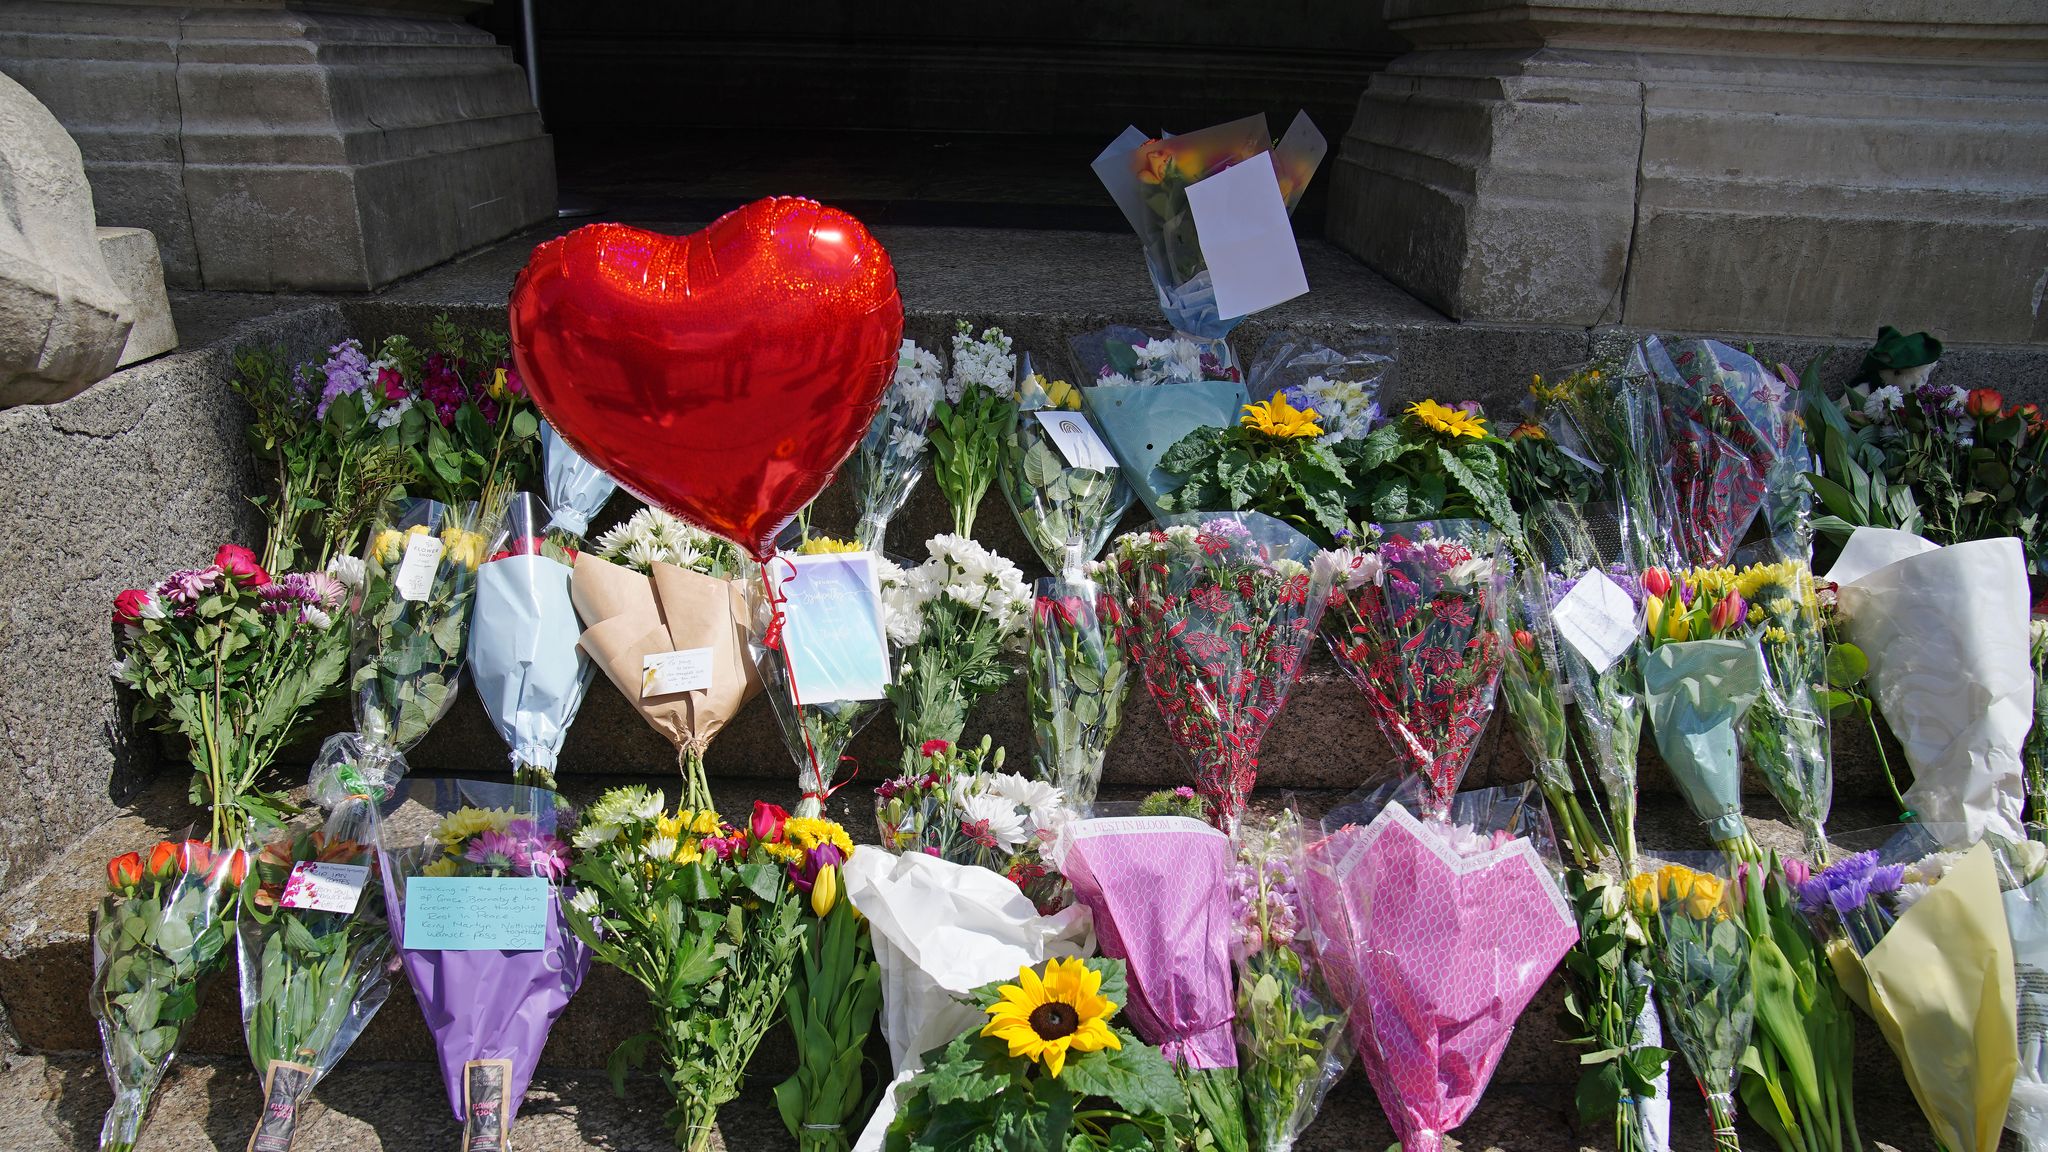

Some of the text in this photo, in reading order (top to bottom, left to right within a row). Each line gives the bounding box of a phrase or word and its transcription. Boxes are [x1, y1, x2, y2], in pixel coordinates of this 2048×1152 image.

[1093, 821, 1120, 833] BEST
[1121, 821, 1136, 831] IN
[1136, 819, 1171, 831] BLOOM
[416, 885, 456, 895] Thinking
